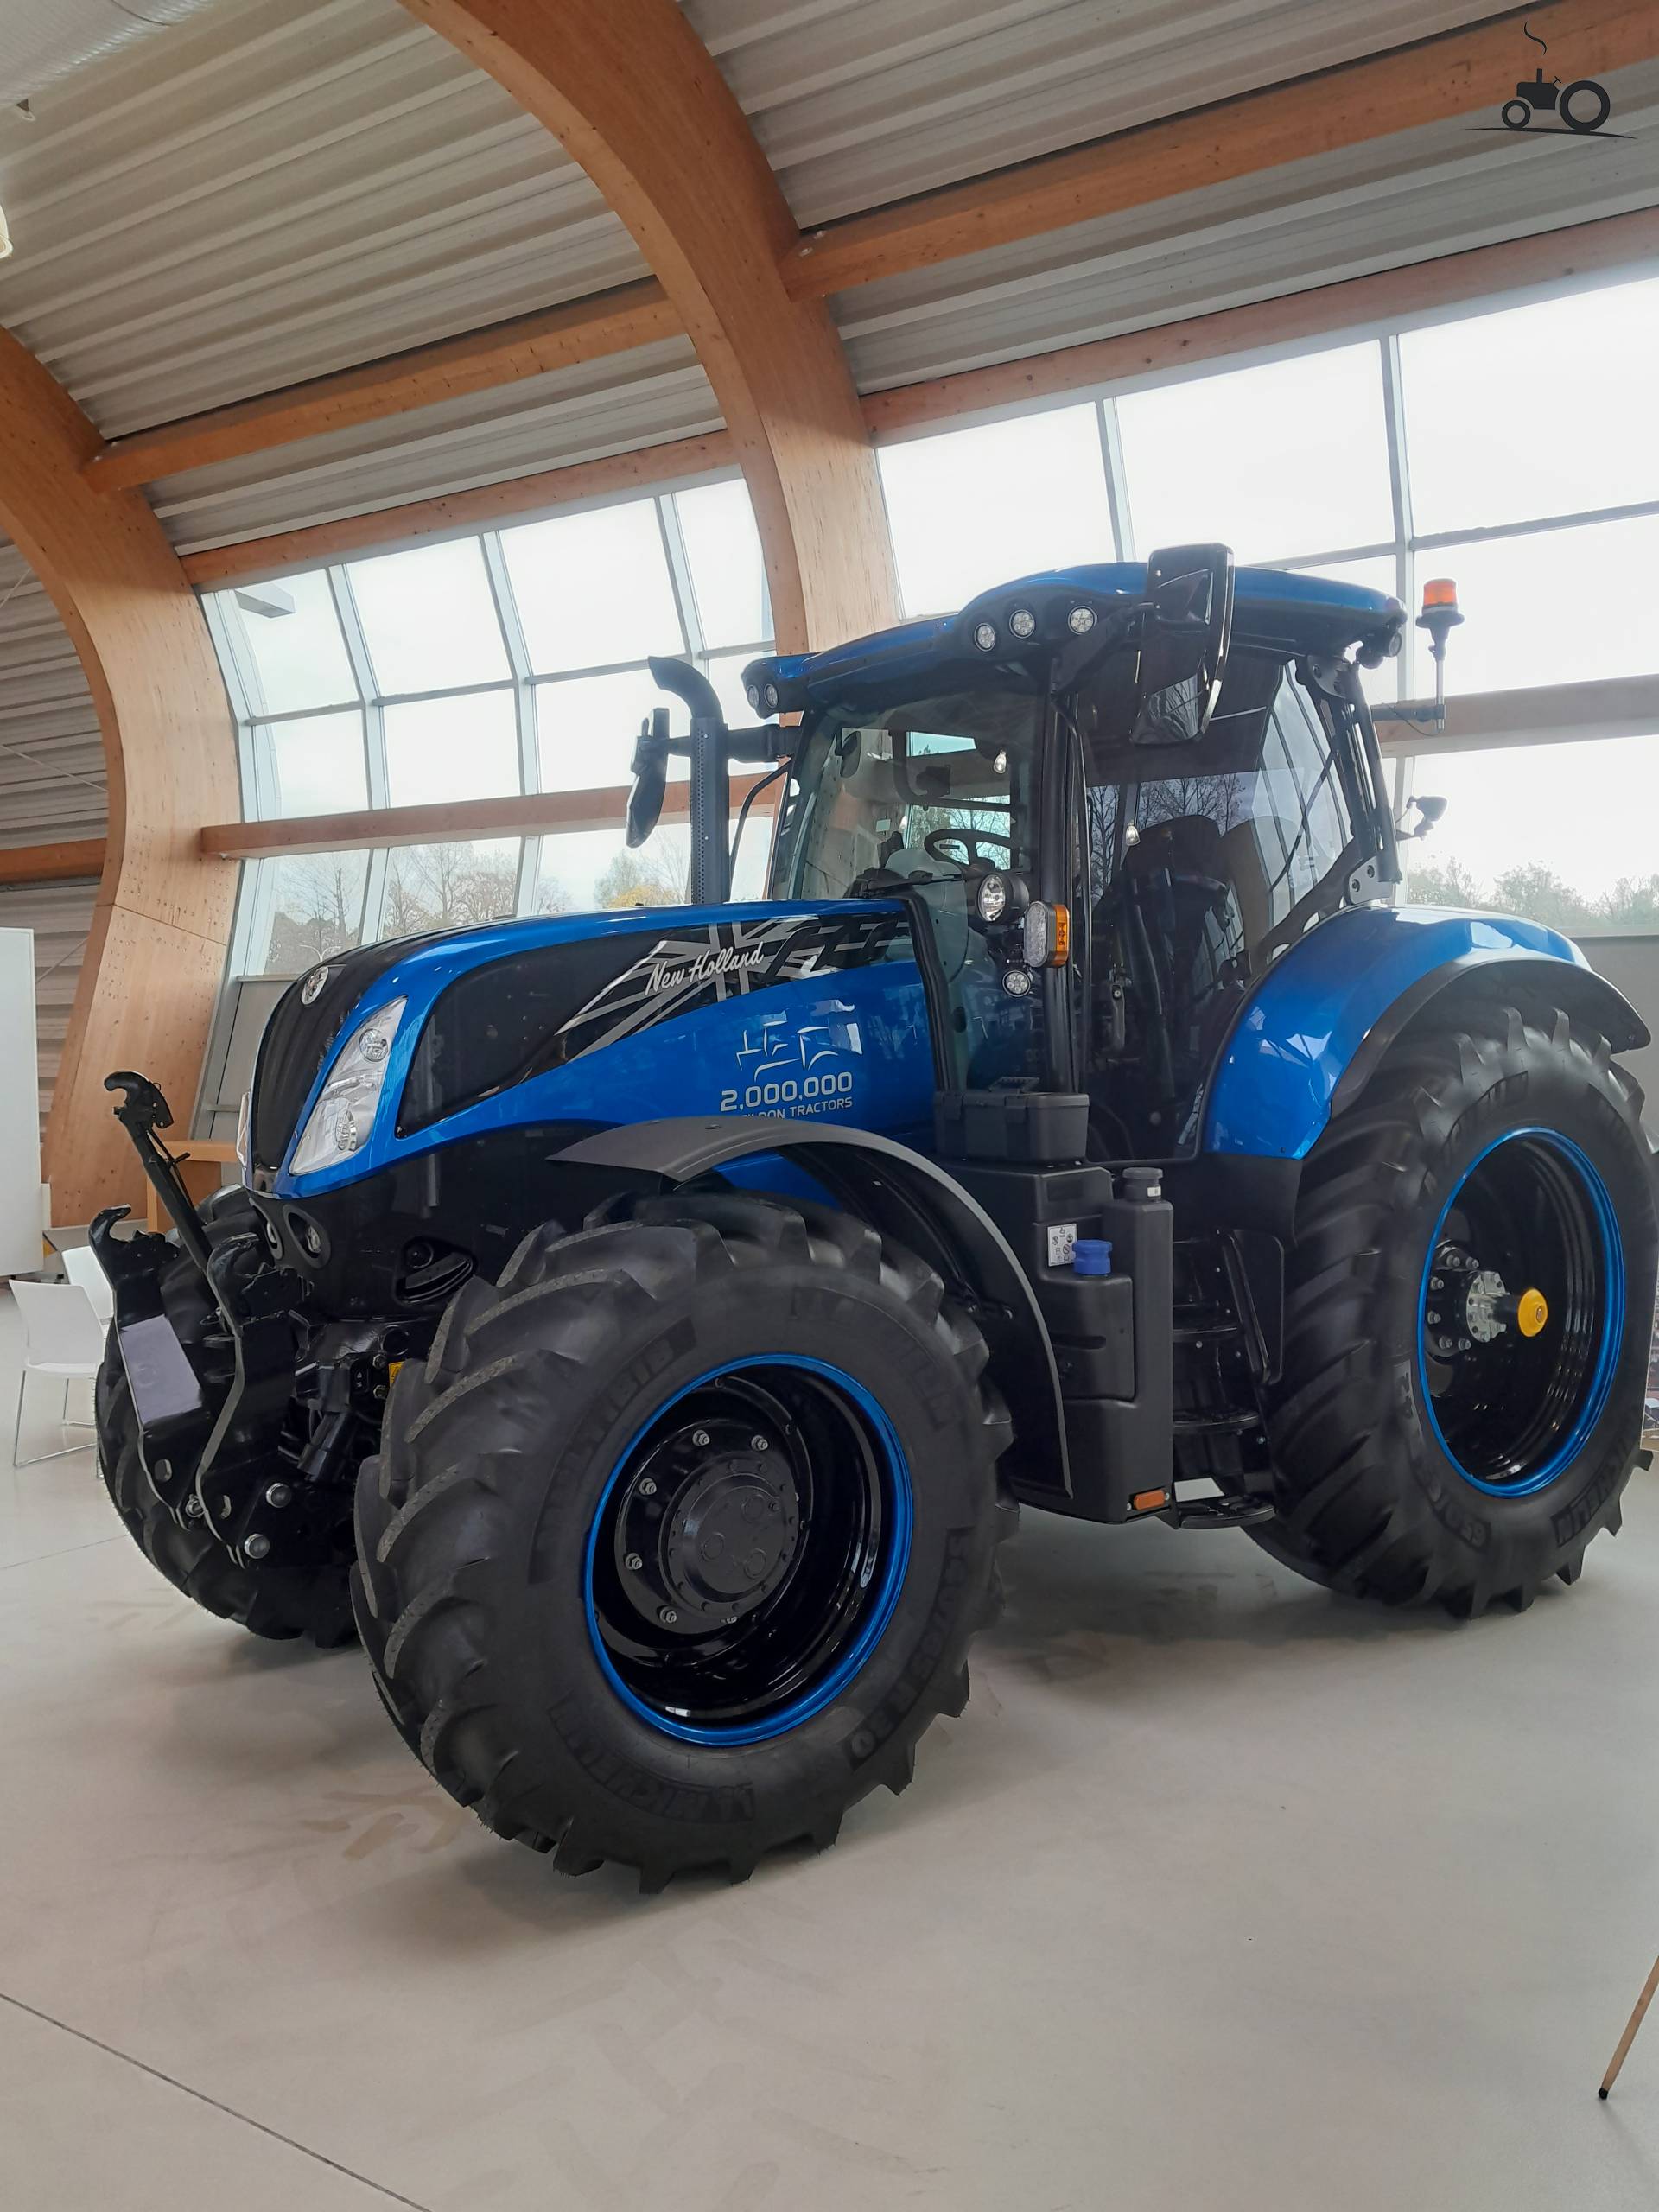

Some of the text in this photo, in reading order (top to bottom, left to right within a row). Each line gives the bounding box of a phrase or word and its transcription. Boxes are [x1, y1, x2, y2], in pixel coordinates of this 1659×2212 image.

[645, 941, 764, 996] New Holland
[721, 1071, 853, 1112] 2,000,000
[789, 1096, 853, 1117] TRACTORS
